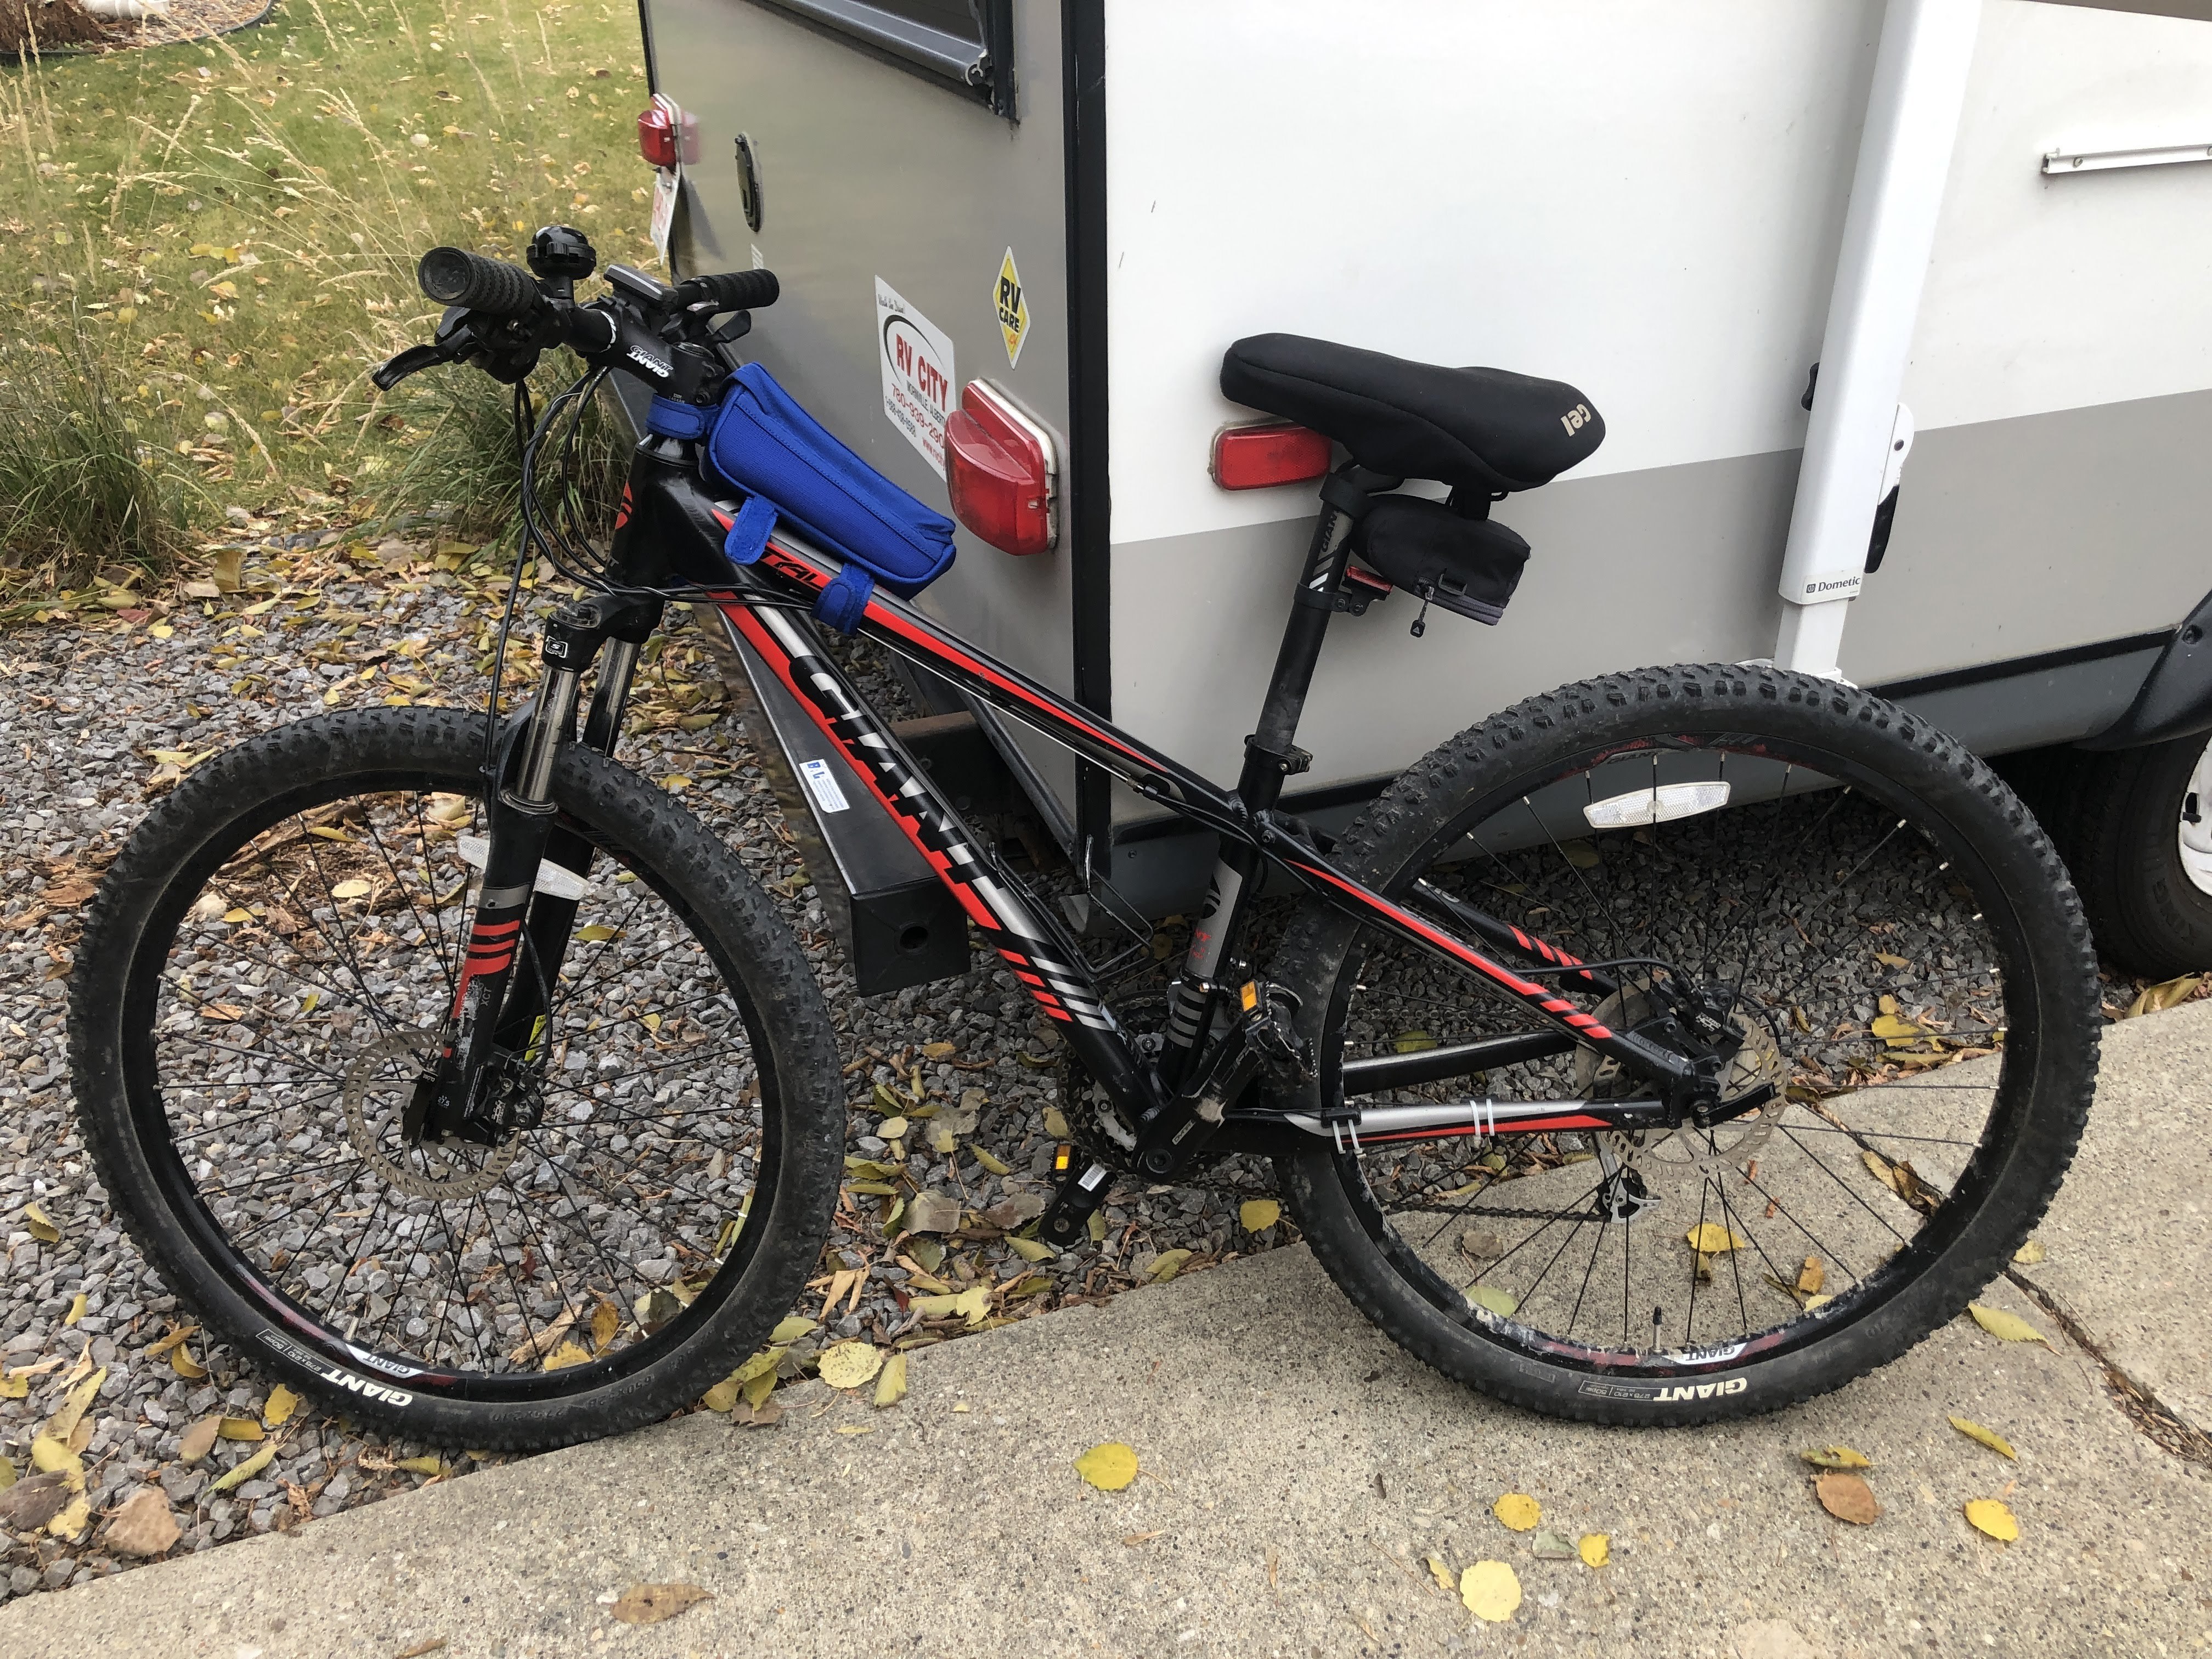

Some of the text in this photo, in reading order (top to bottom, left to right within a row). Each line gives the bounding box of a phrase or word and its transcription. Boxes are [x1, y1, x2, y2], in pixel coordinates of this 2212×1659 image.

[1000, 276, 1021, 314] RV
[999, 307, 1020, 333] CARE
[627, 352, 669, 377] GIANT
[630, 345, 674, 371] GIANT
[896, 333, 948, 413] RV CITY
[891, 383, 944, 449] 780-939-290
[929, 401, 945, 428] ALBERT
[1560, 403, 1591, 437] Gel
[1321, 512, 1338, 553] GIAN
[760, 549, 824, 592] TAL
[1818, 577, 1860, 592] Dometic
[789, 655, 1004, 891] GIANT
[479, 986, 493, 1007] XCT
[363, 1354, 411, 1375] GIANT
[323, 1369, 413, 1407] GIANT
[1652, 1377, 1747, 1402] GIANT
